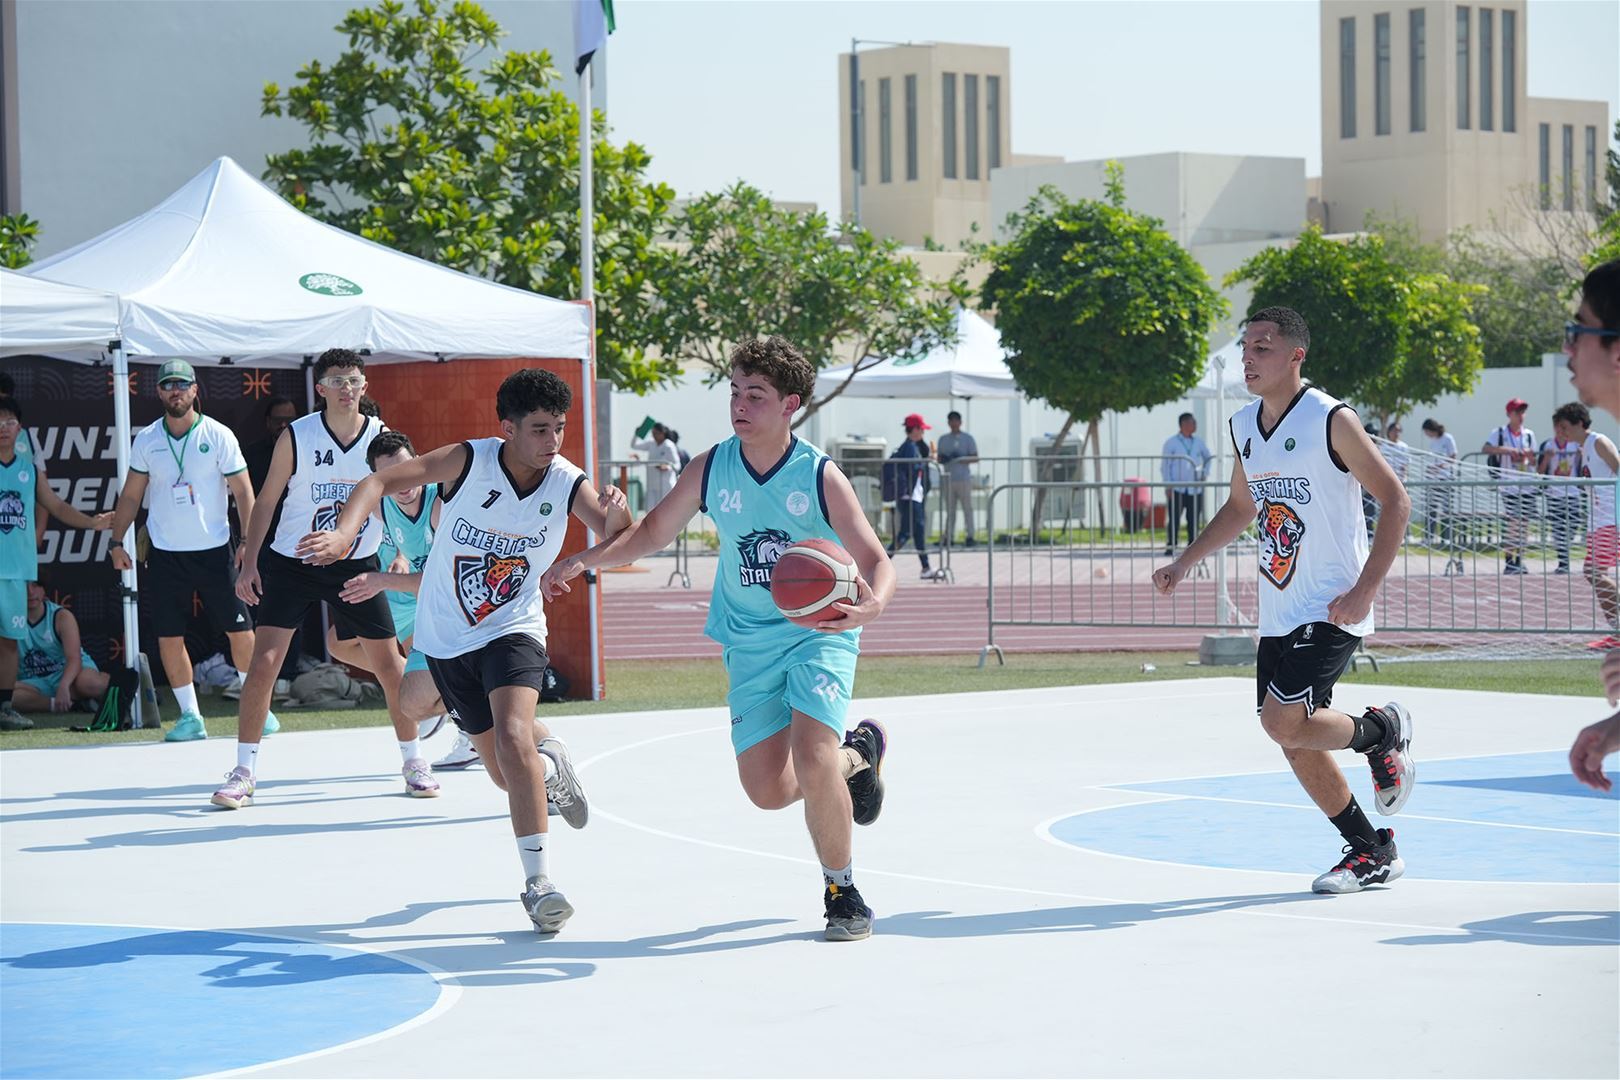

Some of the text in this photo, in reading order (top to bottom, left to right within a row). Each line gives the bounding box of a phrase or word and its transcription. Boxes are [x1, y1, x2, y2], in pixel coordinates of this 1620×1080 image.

[315, 450, 334, 466] 34
[1242, 437, 1252, 459] 4
[311, 482, 356, 504] CHEET
[718, 488, 743, 514] 24
[0, 515, 26, 529] LLIONS
[740, 565, 771, 586] STAL
[12, 615, 26, 629] 90
[811, 673, 840, 703] 24
